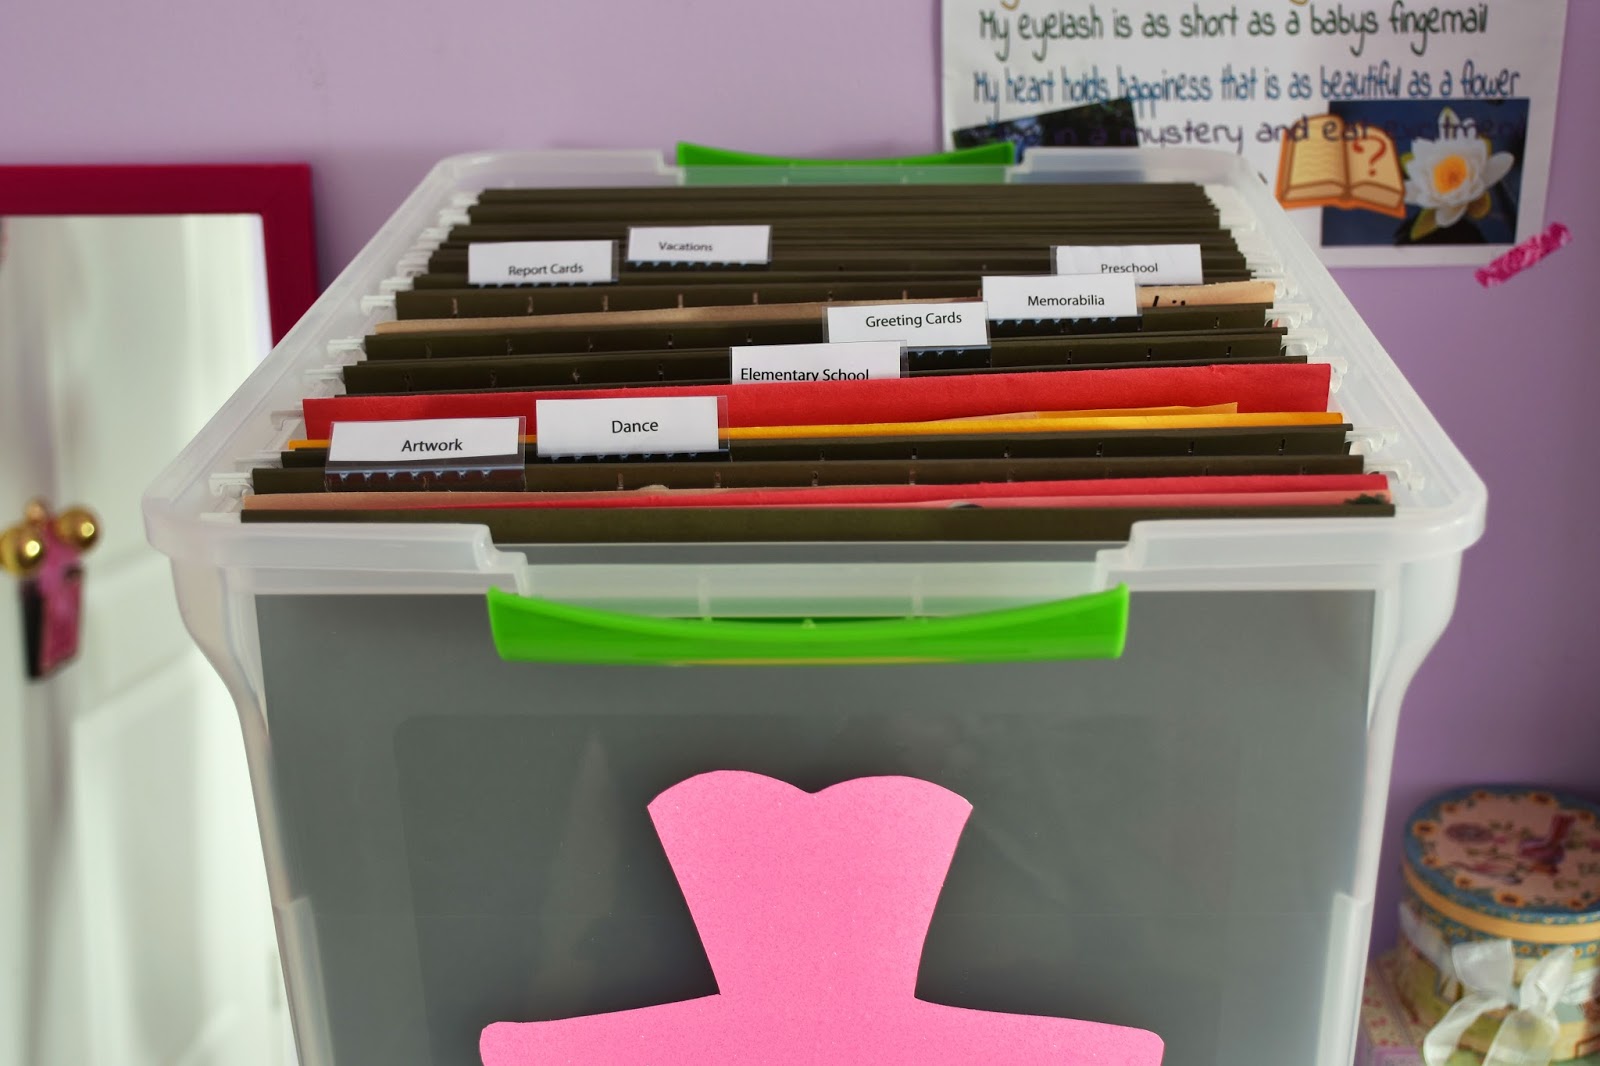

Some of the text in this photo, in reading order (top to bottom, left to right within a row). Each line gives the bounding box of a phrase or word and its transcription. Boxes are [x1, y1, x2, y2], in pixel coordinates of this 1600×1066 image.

[979, 9, 1010, 61] My
[1018, 4, 1104, 61] eyelash
[1112, 9, 1132, 38] is
[1141, 11, 1171, 38] as
[1180, 4, 1239, 37] short
[1247, 9, 1276, 36] as
[1285, 9, 1300, 35] a
[1310, 4, 1379, 57] babys
[973, 59, 1521, 127] My heart holds happiness that is as beautiful as a flower
[1120, 121, 1244, 154] mystery
[1256, 114, 1309, 142] and
[659, 241, 713, 252] Vacations
[508, 263, 584, 277] Report Cards
[1100, 262, 1159, 274] Preschool
[1027, 294, 1105, 307] Memorabilia
[865, 311, 962, 329] Greeting Cards
[740, 367, 869, 381] Elementary School
[611, 420, 659, 434] Dance
[401, 438, 463, 453] Artwork
